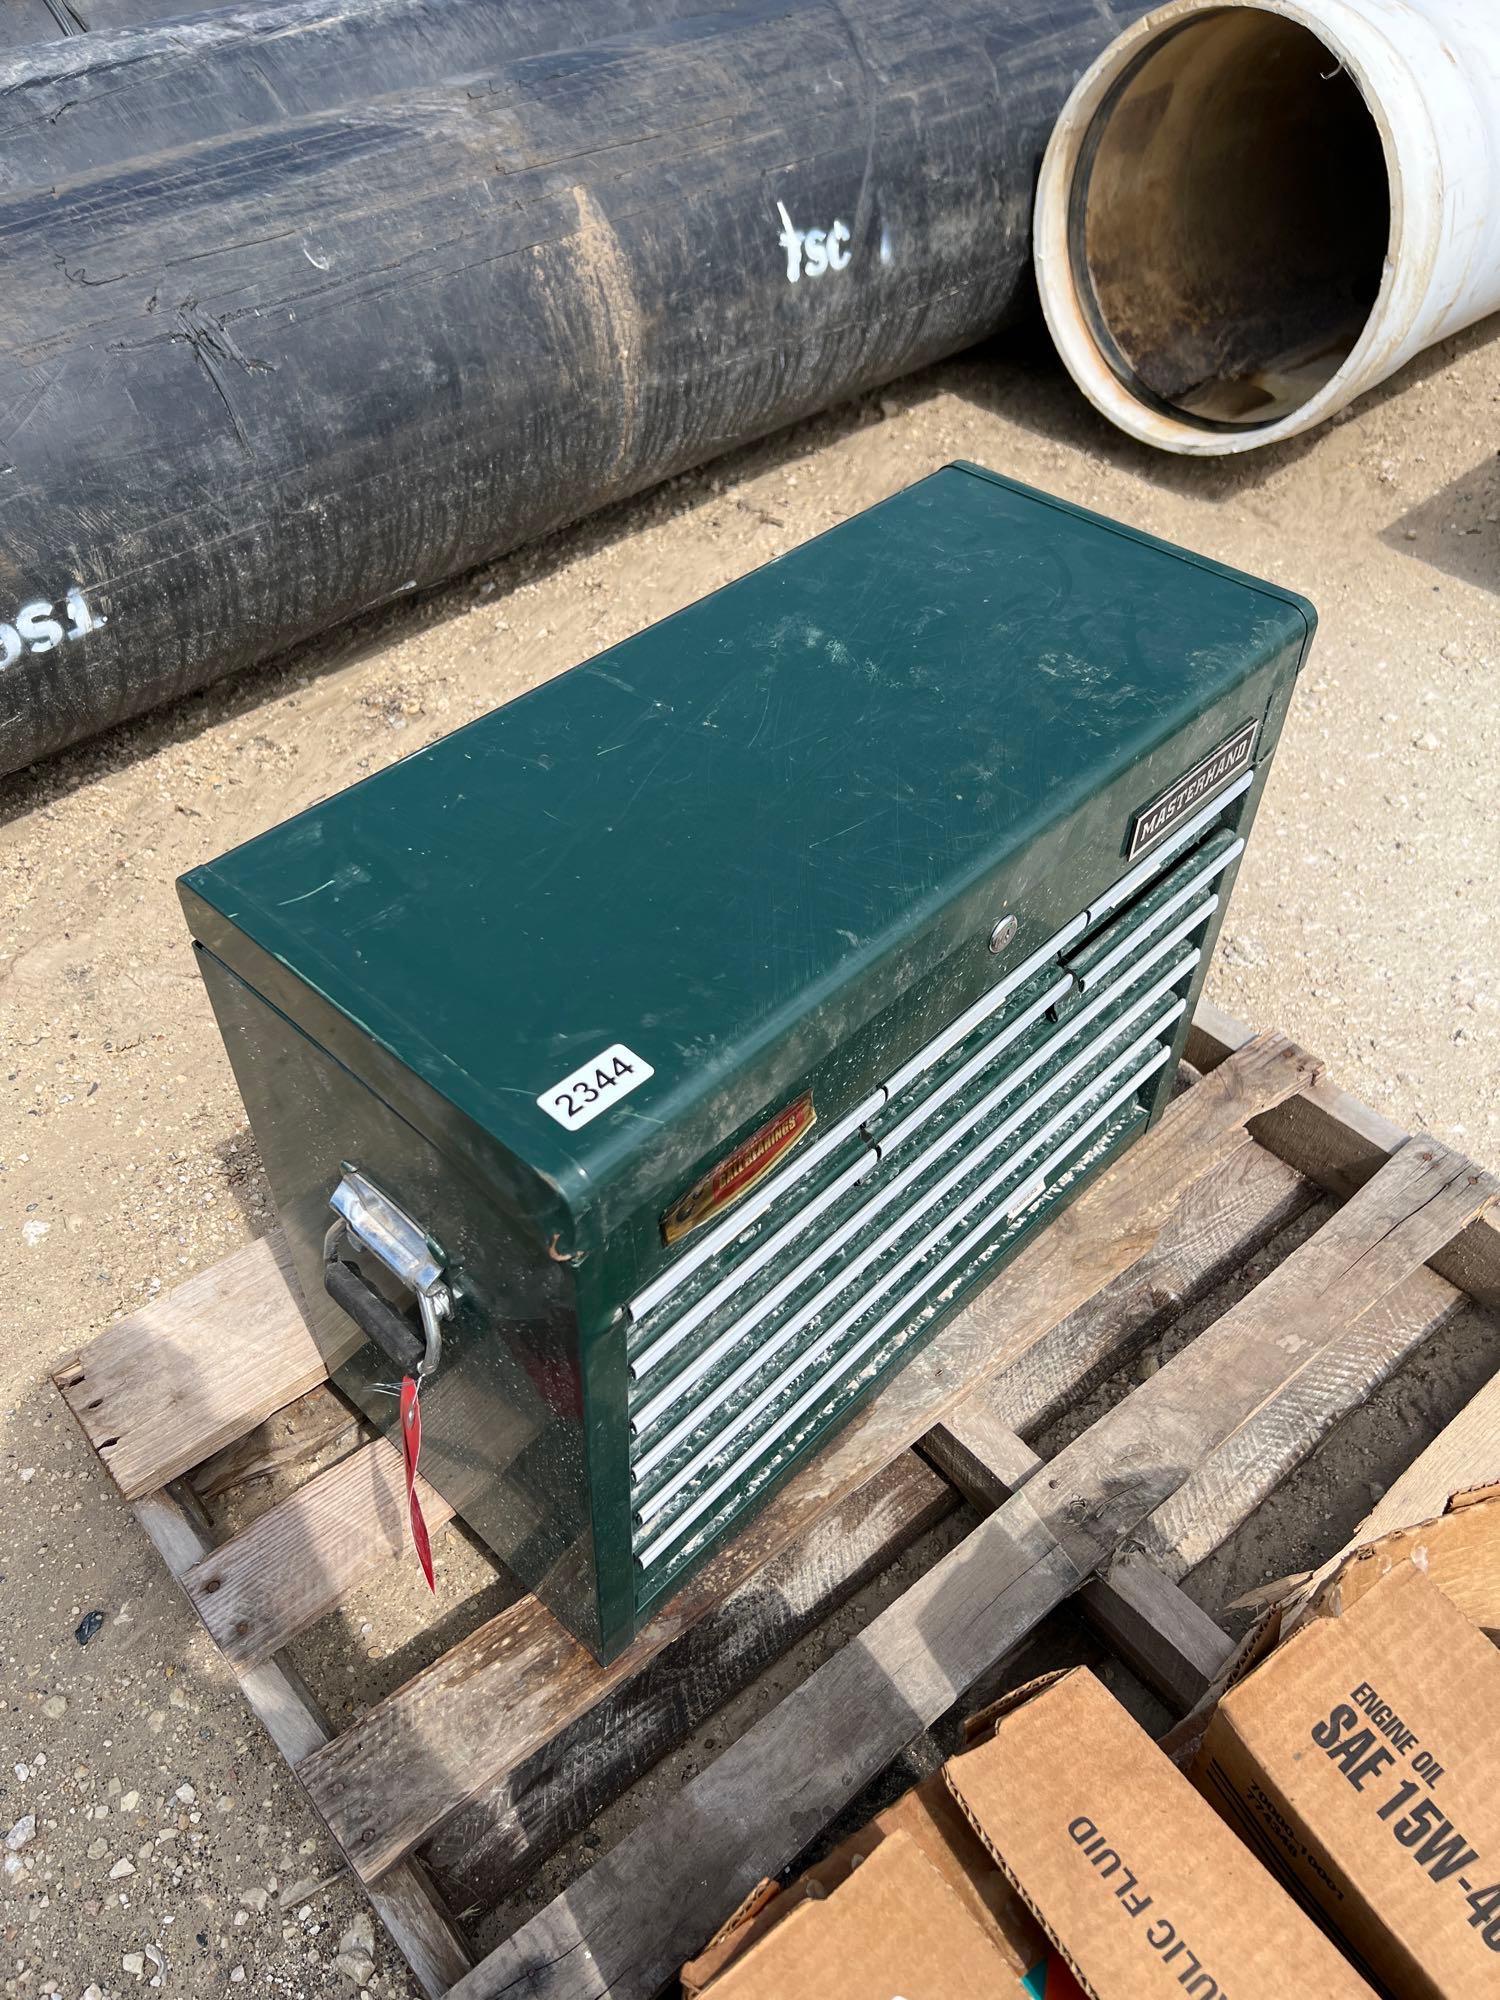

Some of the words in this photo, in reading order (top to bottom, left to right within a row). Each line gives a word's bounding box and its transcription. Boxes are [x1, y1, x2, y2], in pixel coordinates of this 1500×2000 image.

[1140, 739, 1248, 841] MASTERHAND
[555, 1056, 634, 1117] 2344
[1311, 1703, 1396, 1792] SAE
[1350, 1682, 1419, 1756] ENGINE
[1411, 1751, 1445, 1790] OIL
[1068, 1816, 1154, 1918] FLUID
[1147, 1919, 1228, 2000] ULIC
